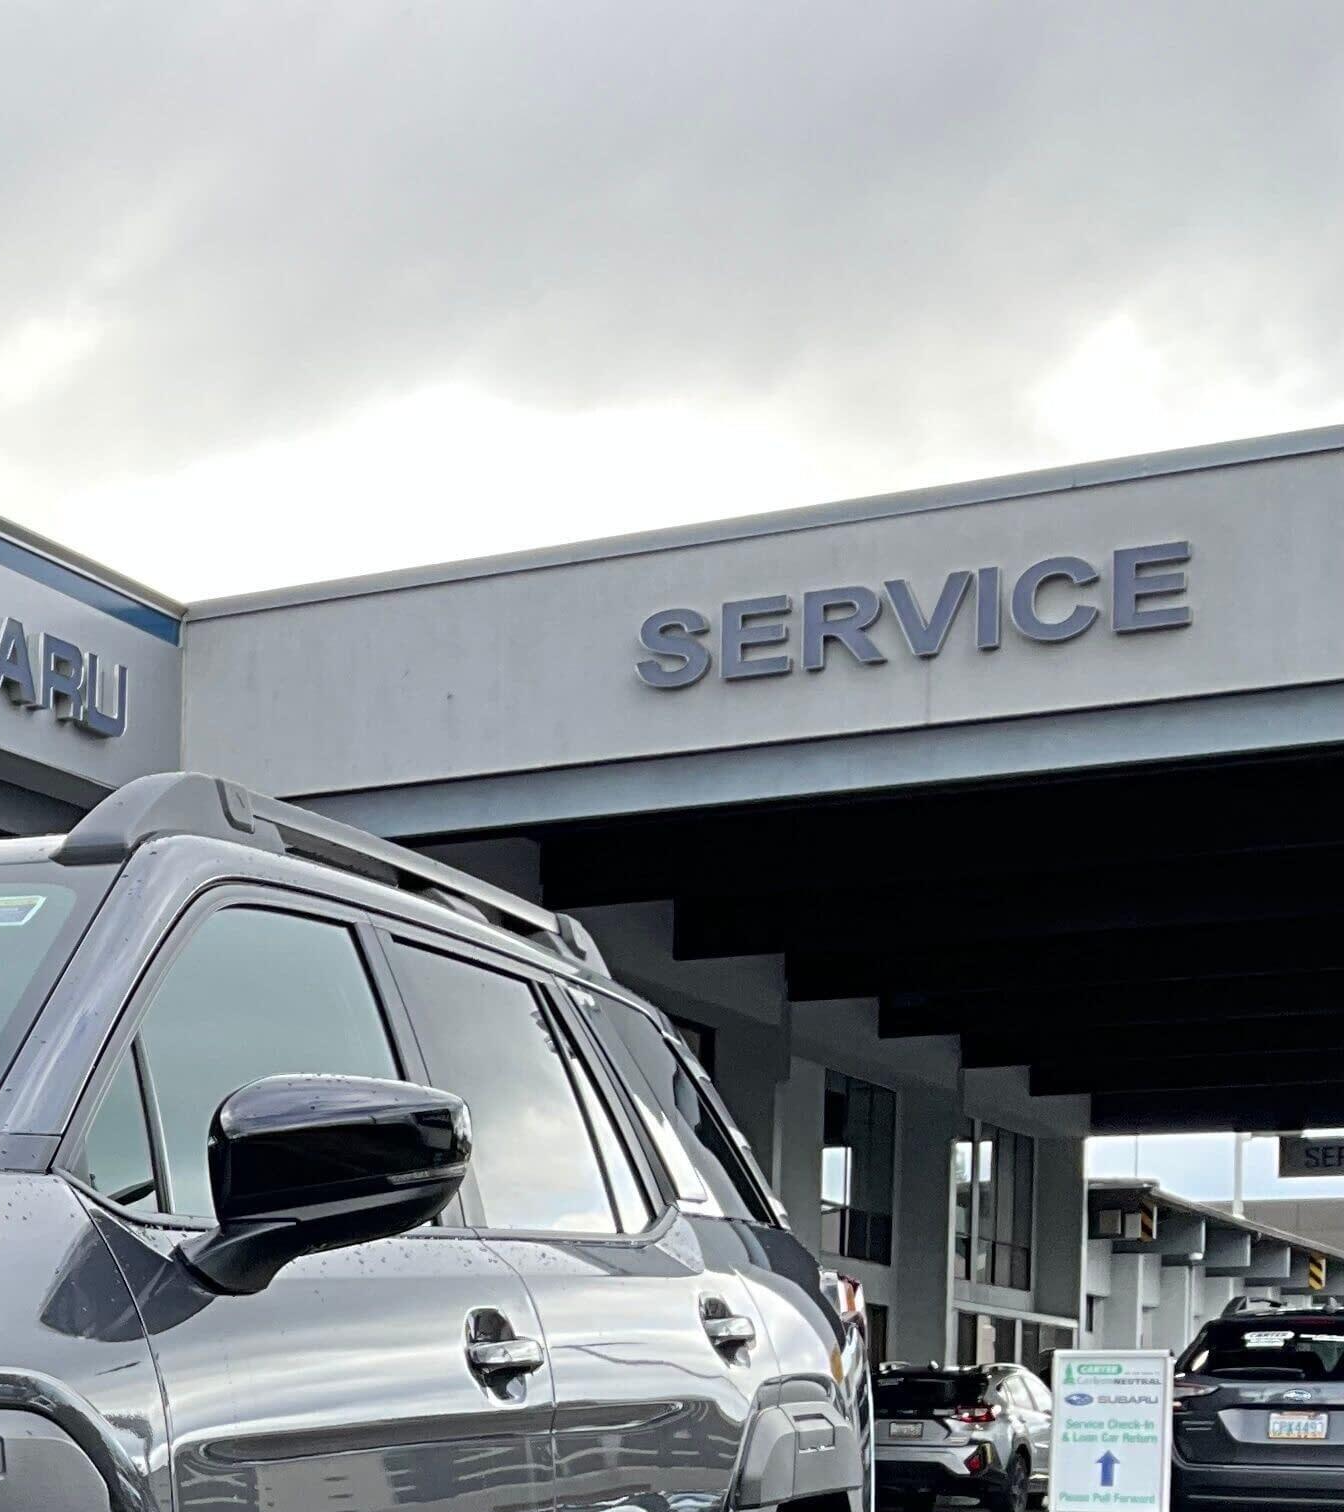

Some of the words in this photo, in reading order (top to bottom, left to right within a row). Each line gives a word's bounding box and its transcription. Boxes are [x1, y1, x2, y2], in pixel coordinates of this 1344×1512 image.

[635, 540, 1192, 689] SERVICE
[1097, 1395, 1159, 1404] SUBARU
[1065, 1419, 1105, 1429] Service
[1107, 1419, 1155, 1430] Check-In
[1073, 1432, 1098, 1442] Loan
[1102, 1432, 1120, 1442] Car
[1123, 1432, 1158, 1443] Return
